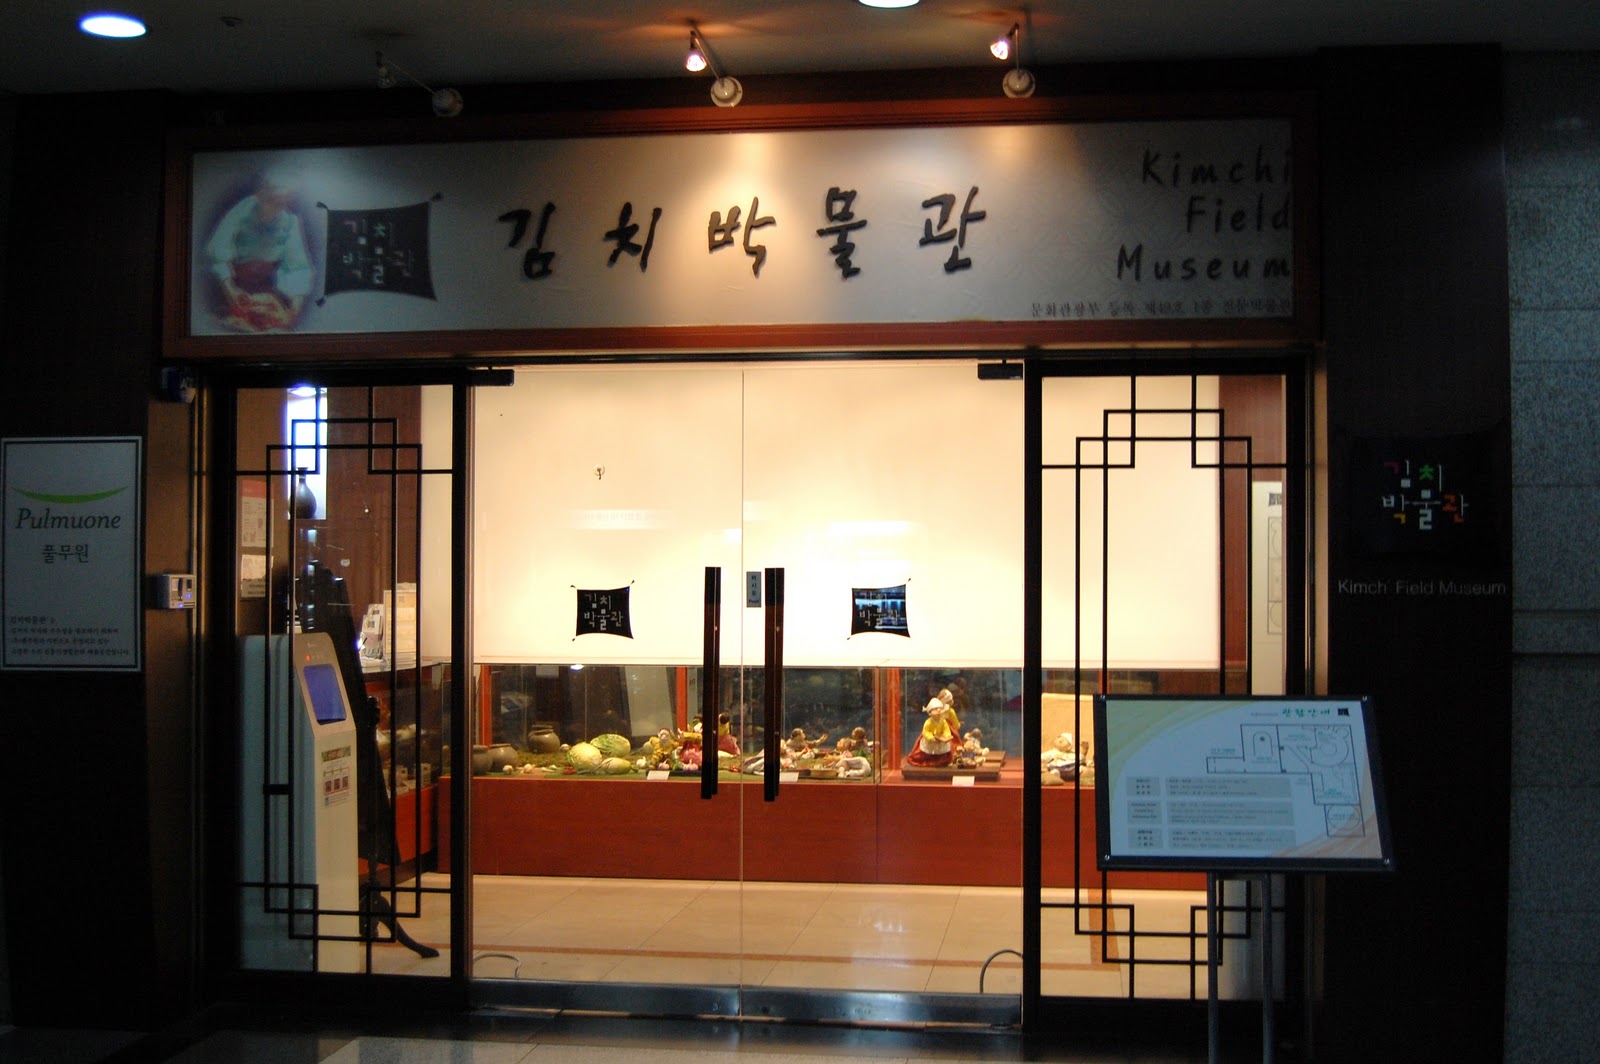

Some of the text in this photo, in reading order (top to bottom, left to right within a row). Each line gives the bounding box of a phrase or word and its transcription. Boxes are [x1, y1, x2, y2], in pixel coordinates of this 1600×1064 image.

[1186, 192, 1290, 233] Field
[1116, 243, 1291, 281] Museum
[1384, 460, 1442, 491] 김치
[15, 507, 122, 530] Pulmuone
[1382, 489, 1469, 530] 박물관
[42, 543, 90, 564] 풀무원
[1338, 579, 1507, 595] Kimch Field Museum
[584, 593, 612, 611] 김치
[584, 608, 624, 631] 박물관
